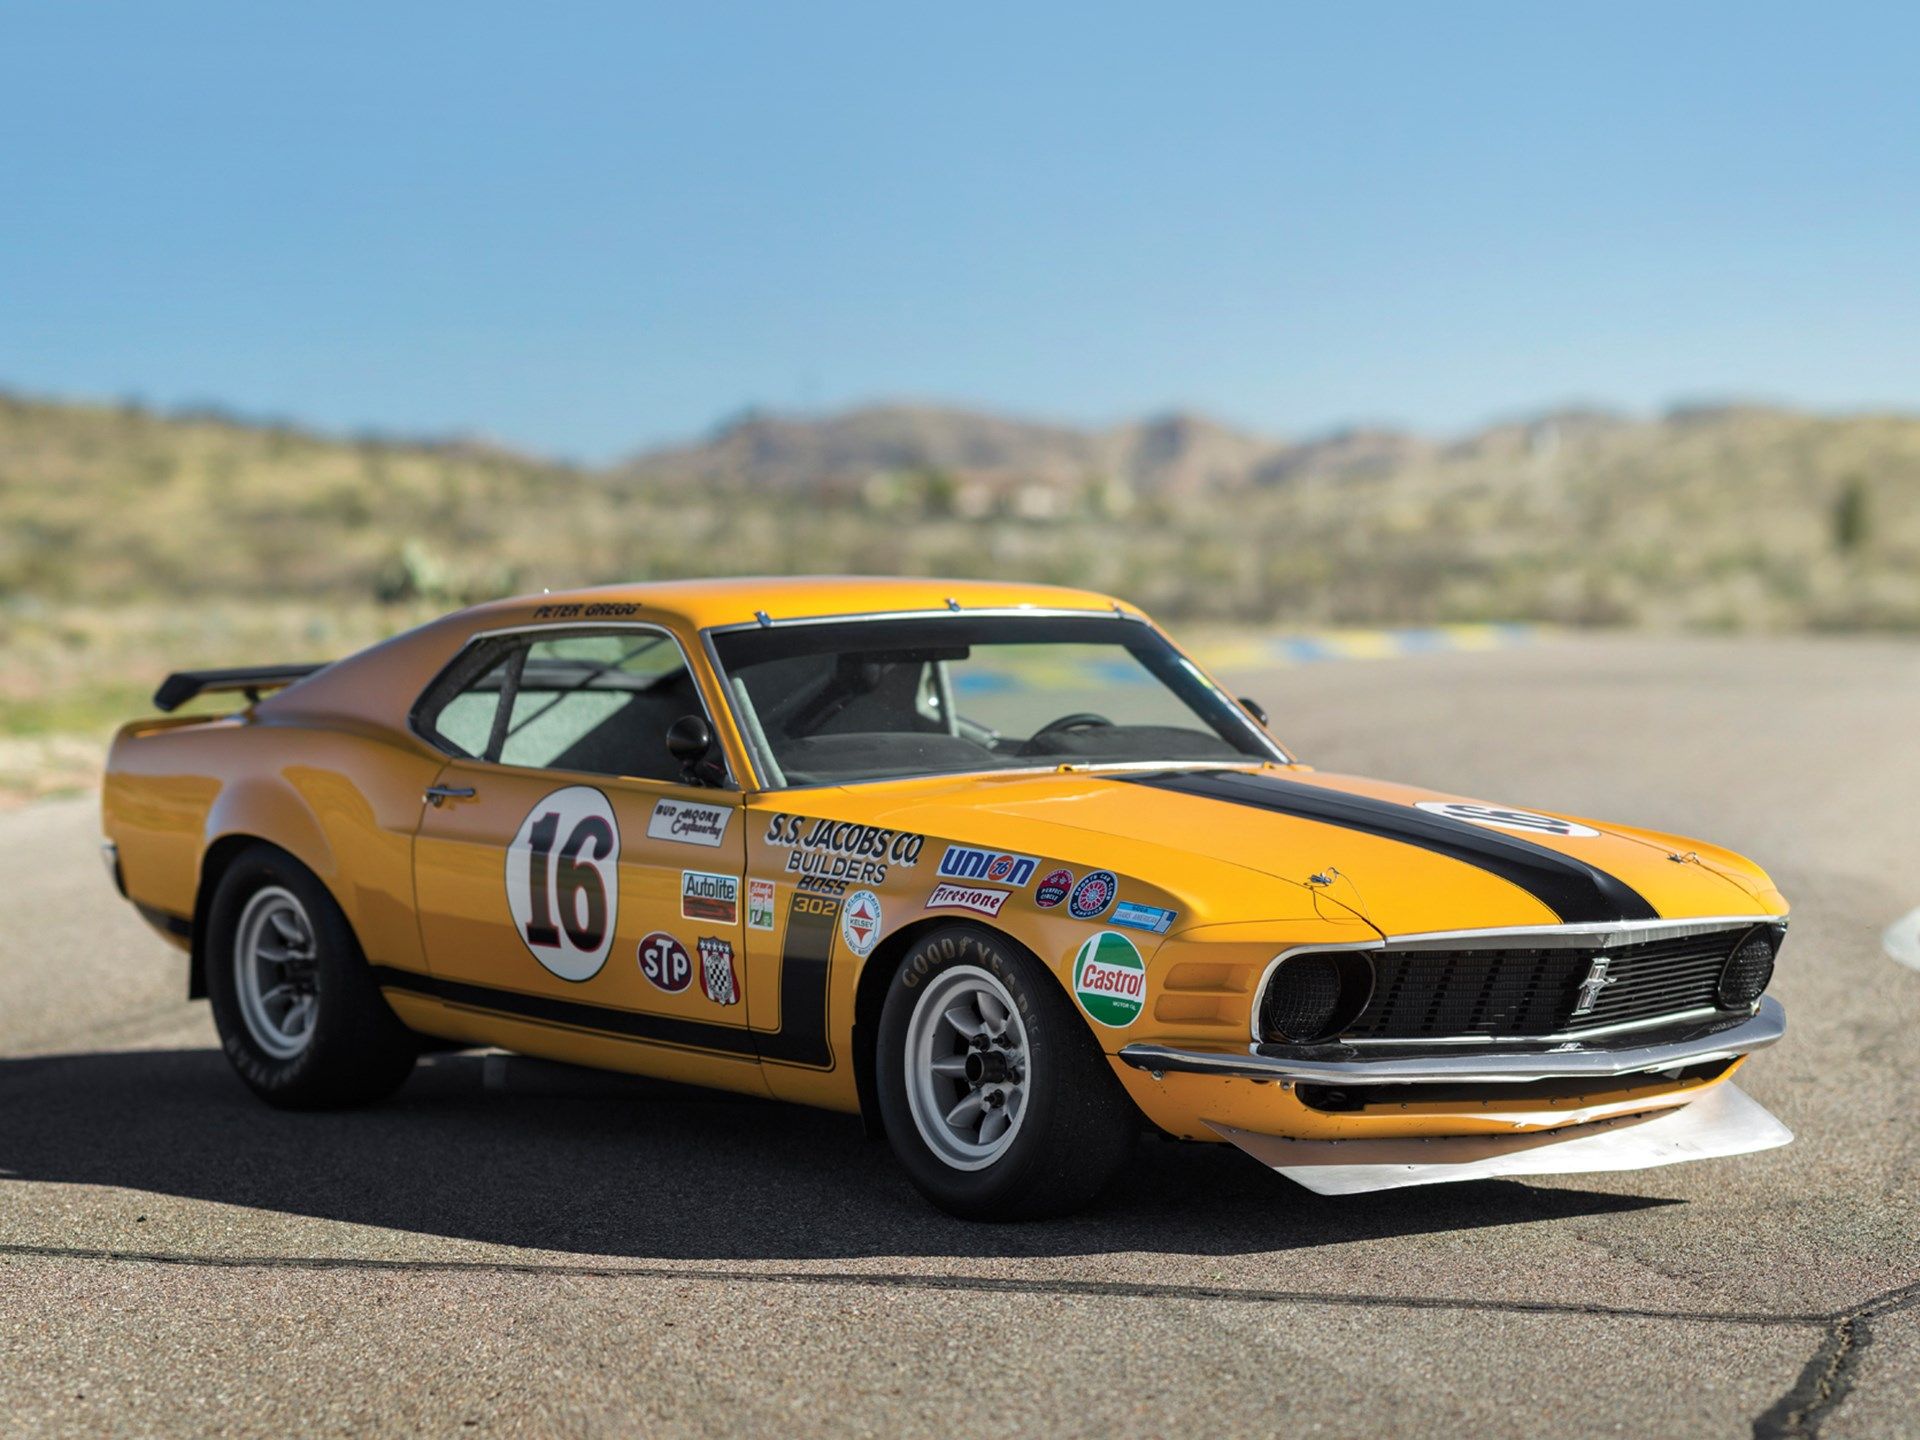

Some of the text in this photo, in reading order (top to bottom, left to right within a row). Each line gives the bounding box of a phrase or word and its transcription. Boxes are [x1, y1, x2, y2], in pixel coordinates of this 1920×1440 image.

[533, 604, 583, 619] PETER
[655, 804, 721, 823] BUD MOORE
[1443, 804, 1571, 835] 16
[765, 813, 926, 868] S.S. JACOBS CO.
[785, 850, 888, 887] BUILDERS
[940, 848, 1036, 885] UNION
[992, 859, 1010, 874] 76
[526, 812, 614, 953] 16
[685, 875, 735, 900] Autolite
[797, 875, 849, 896] BOSS
[794, 897, 838, 916] 302
[932, 885, 1001, 910] Firestone
[850, 918, 873, 928] KELSEY
[644, 938, 689, 985] STP
[1082, 963, 1144, 997] Castrol
